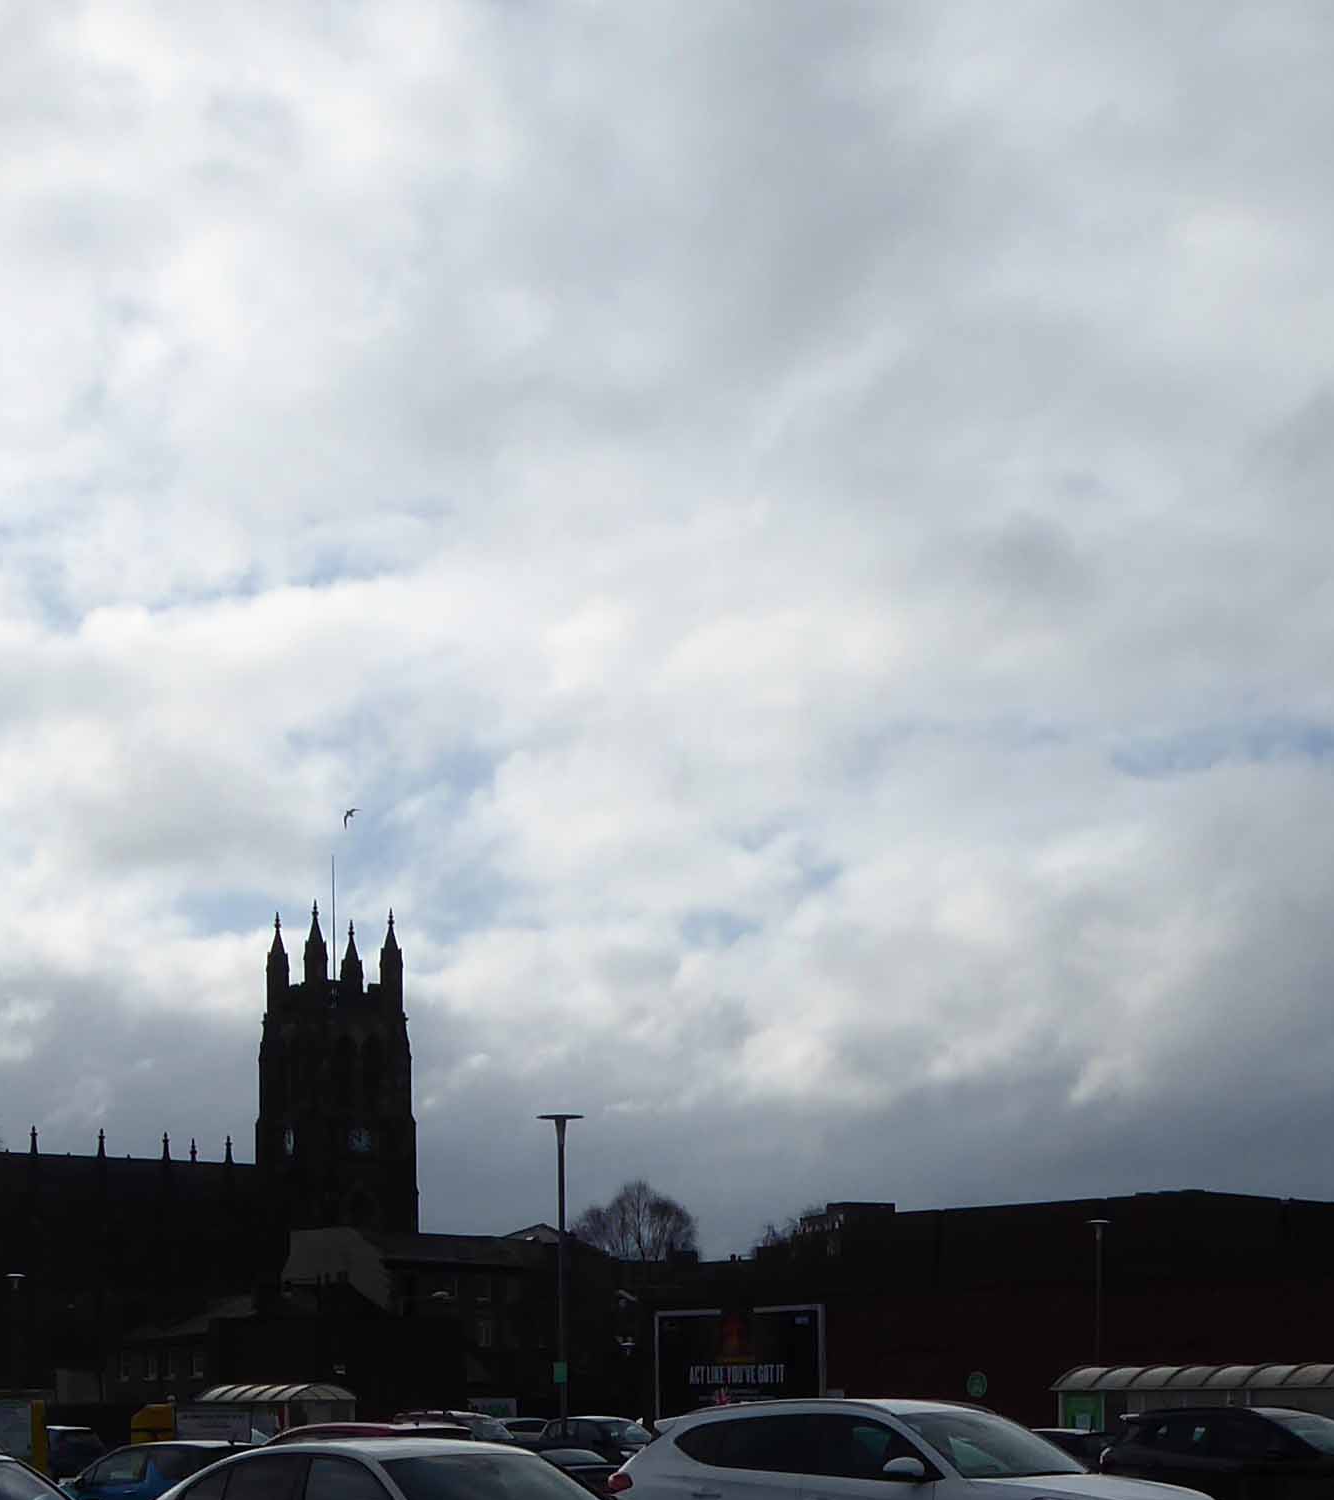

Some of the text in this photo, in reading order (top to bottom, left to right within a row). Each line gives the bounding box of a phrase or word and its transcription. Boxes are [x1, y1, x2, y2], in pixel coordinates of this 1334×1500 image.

[689, 1364, 704, 1385] ACT
[757, 1363, 774, 1384] GOT
[775, 1362, 785, 1384] IT
